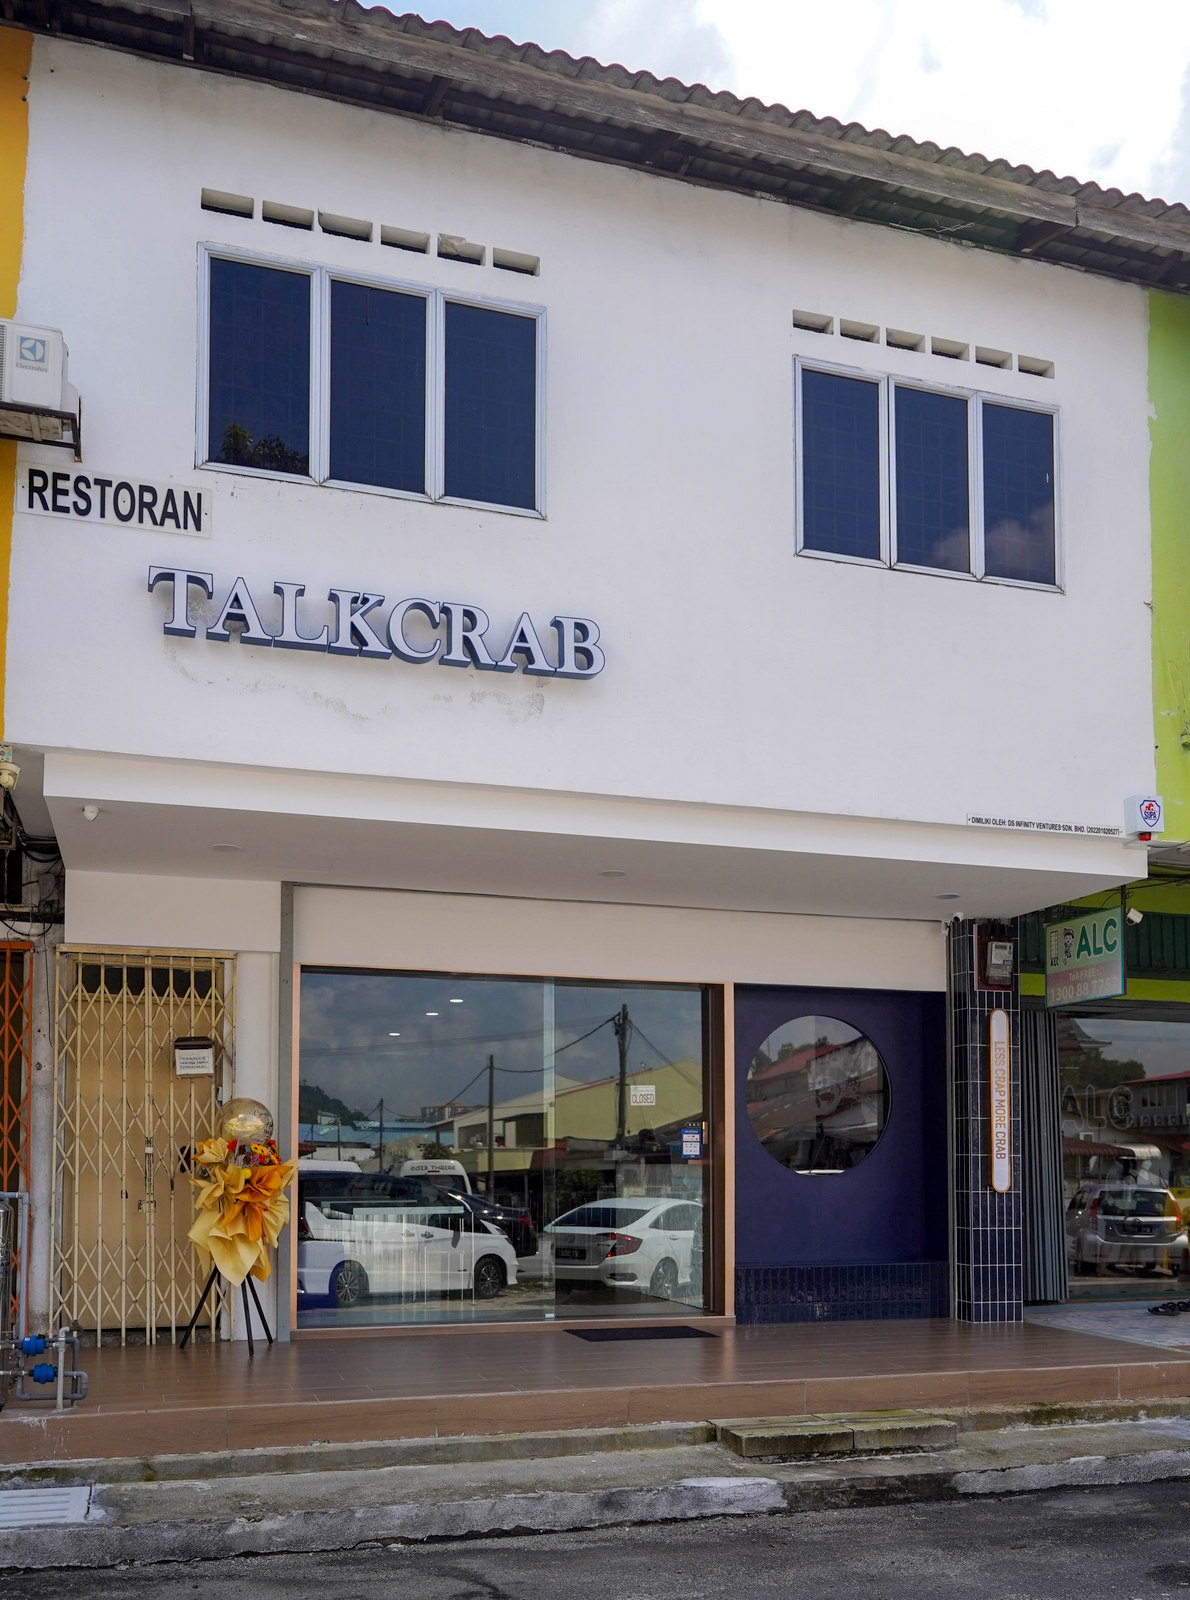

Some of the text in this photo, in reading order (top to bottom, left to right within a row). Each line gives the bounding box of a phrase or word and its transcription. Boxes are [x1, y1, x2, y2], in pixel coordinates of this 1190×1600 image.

[27, 468, 203, 532] RESTORAN
[147, 565, 606, 680] TALKCRAB
[971, 816, 992, 825] DIMILIKI
[992, 818, 1007, 826] OLEH:
[1016, 820, 1036, 829] INFINITY
[1036, 822, 1061, 831] VENTURES
[1076, 918, 1118, 960] ALC
[1050, 985, 1074, 1002] 1300
[1076, 982, 1089, 997] 88
[631, 1093, 655, 1104] CLOSED
[994, 1041, 1007, 1160] LESS CRAP MORE CRAB
